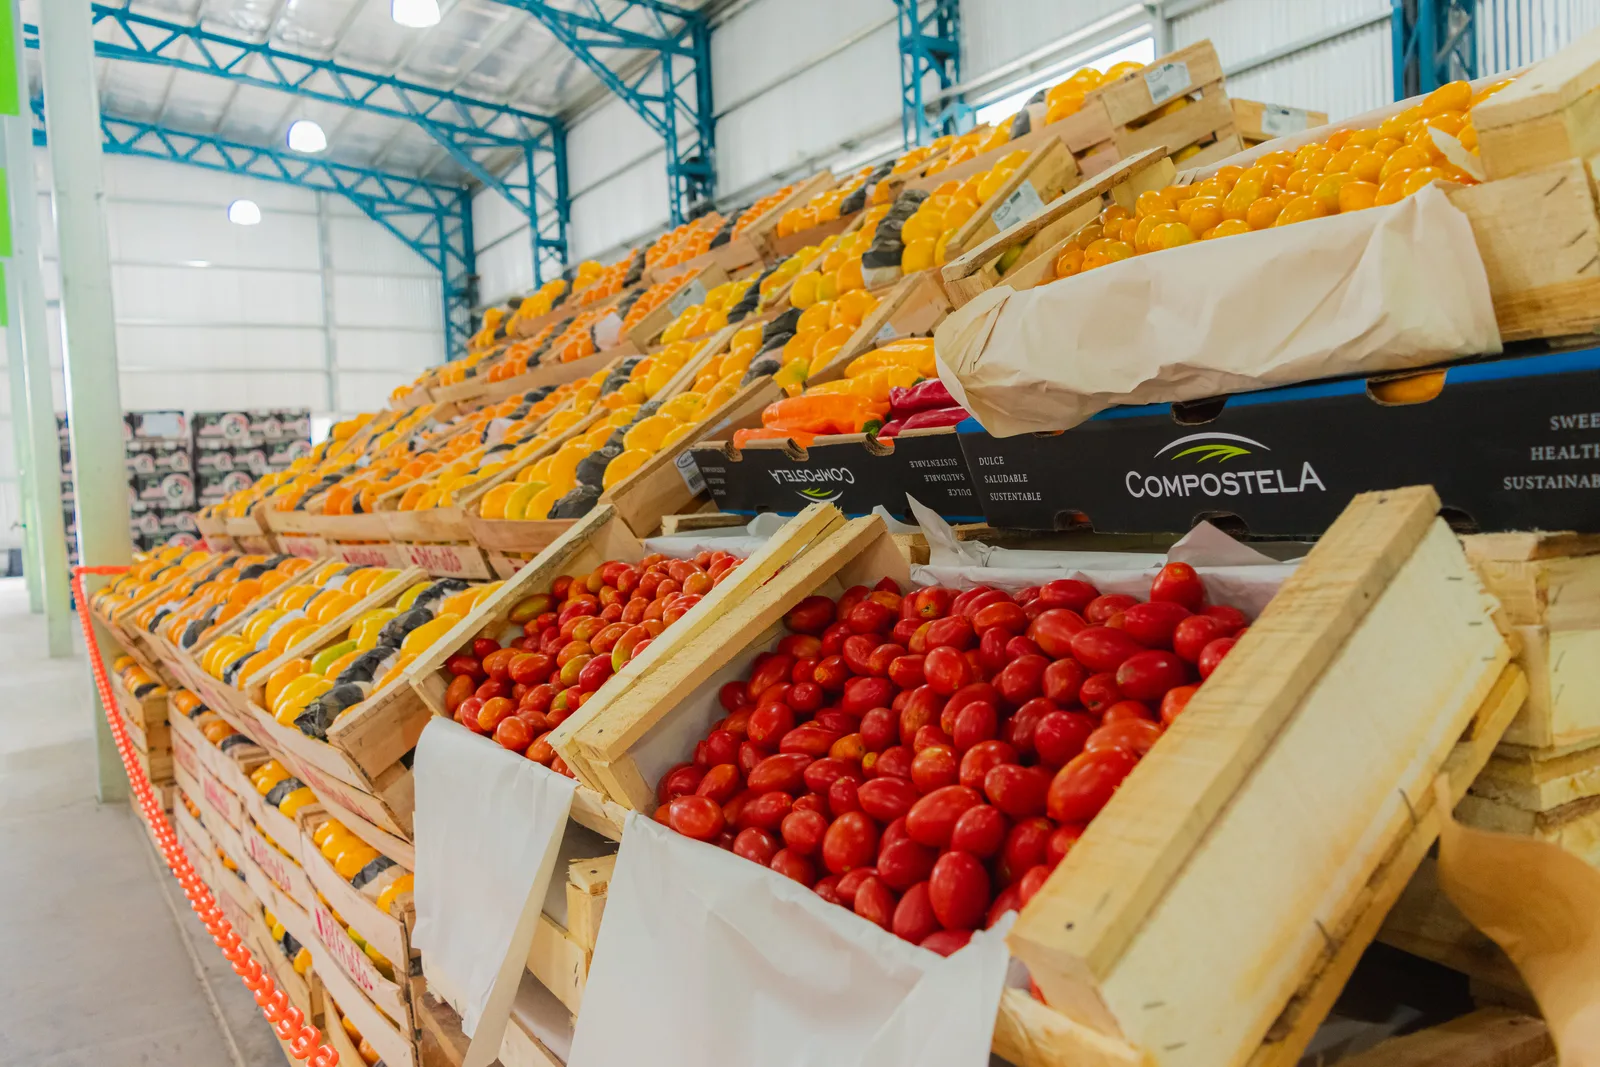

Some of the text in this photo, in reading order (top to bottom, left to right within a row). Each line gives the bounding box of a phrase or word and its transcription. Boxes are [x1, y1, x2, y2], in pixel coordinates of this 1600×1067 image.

[909, 458, 958, 468] SUSTENTABLE
[978, 456, 1004, 466] DULCE
[923, 473, 966, 482] SALUDABLE
[983, 473, 1028, 483] SALUDABLE
[946, 488, 972, 497] DULCE
[989, 491, 1042, 501] SUSTENTABLE
